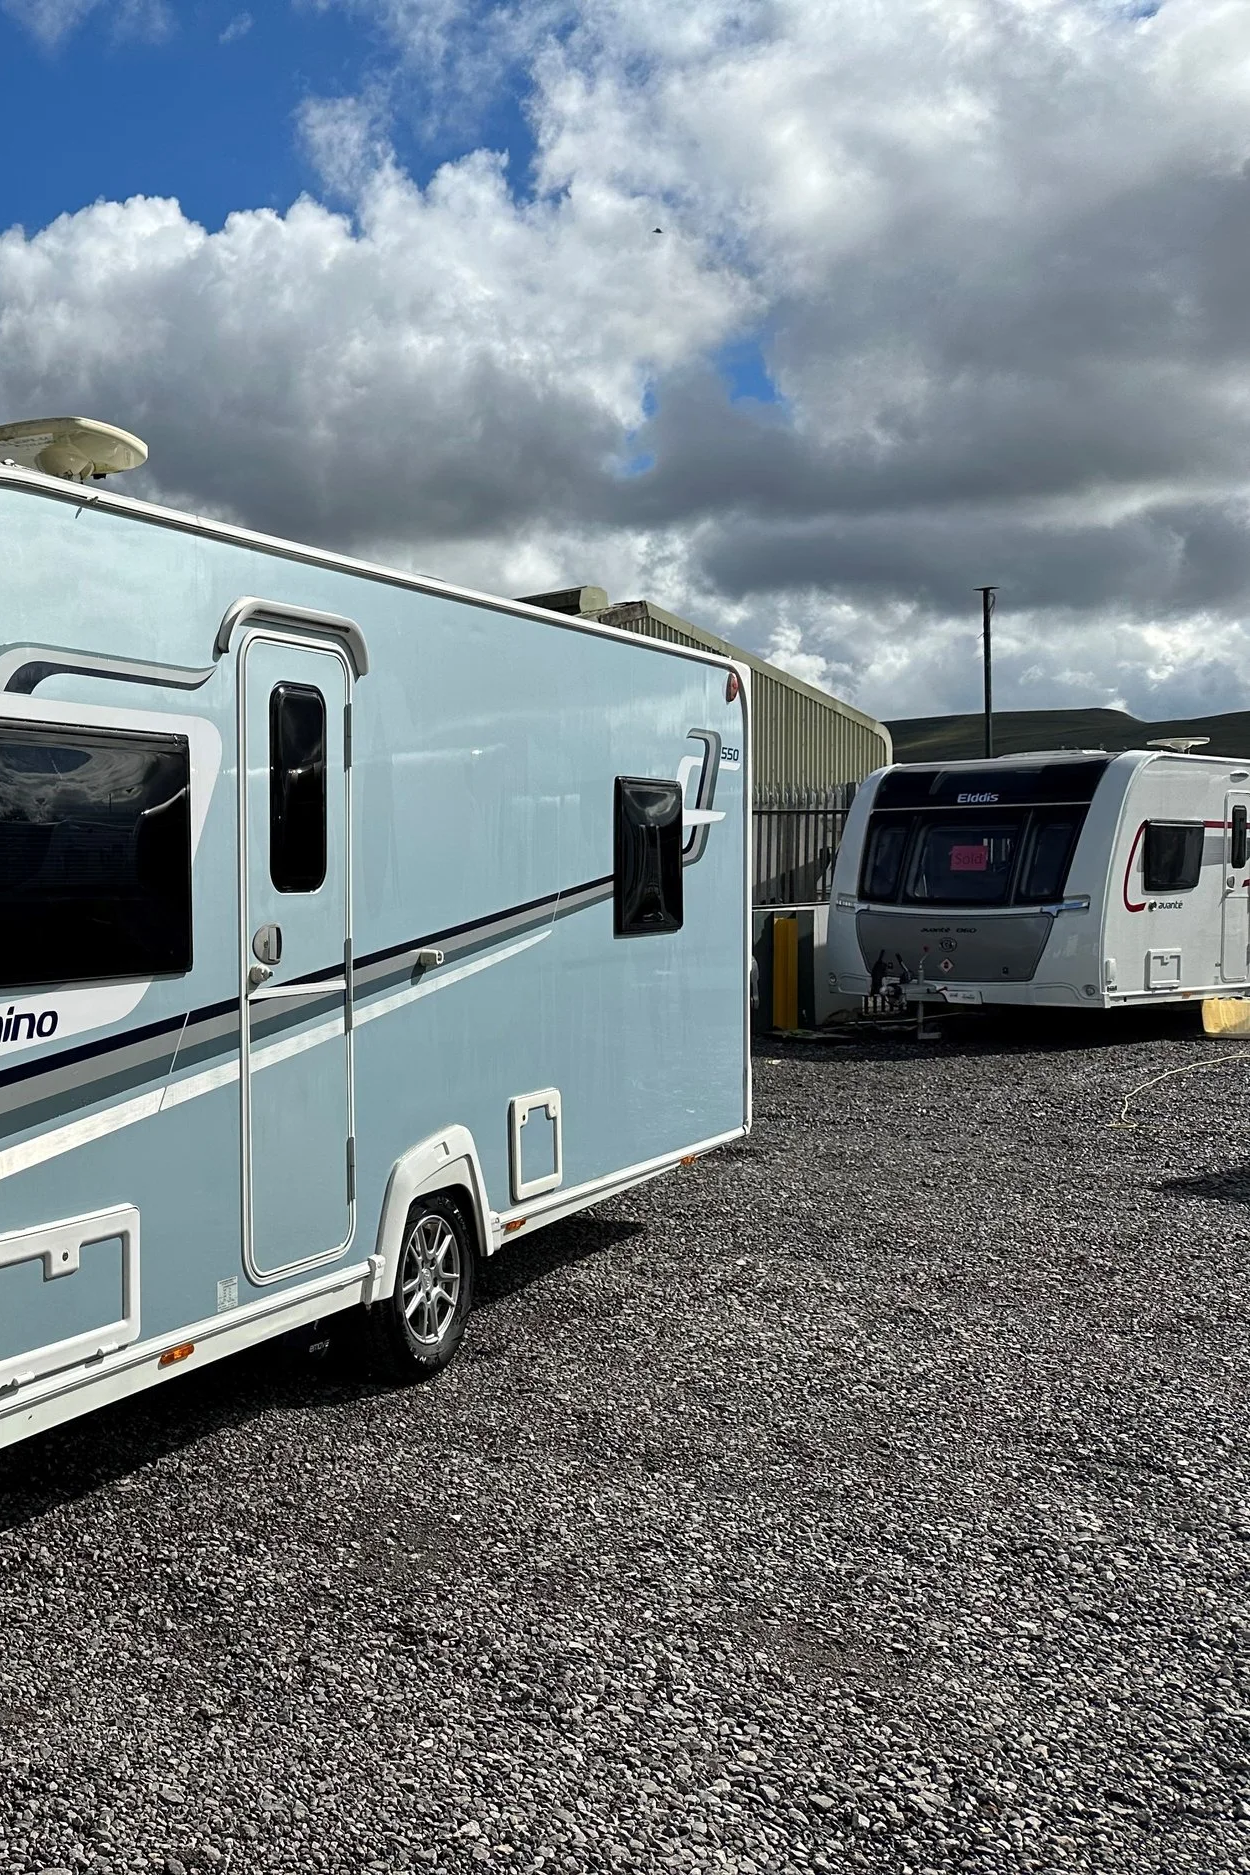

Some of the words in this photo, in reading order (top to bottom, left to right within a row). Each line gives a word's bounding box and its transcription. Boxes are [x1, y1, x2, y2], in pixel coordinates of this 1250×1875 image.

[720, 746, 740, 762] 550
[957, 792, 999, 804] Elddis
[954, 852, 984, 867] Sold
[1158, 900, 1184, 910] avanté
